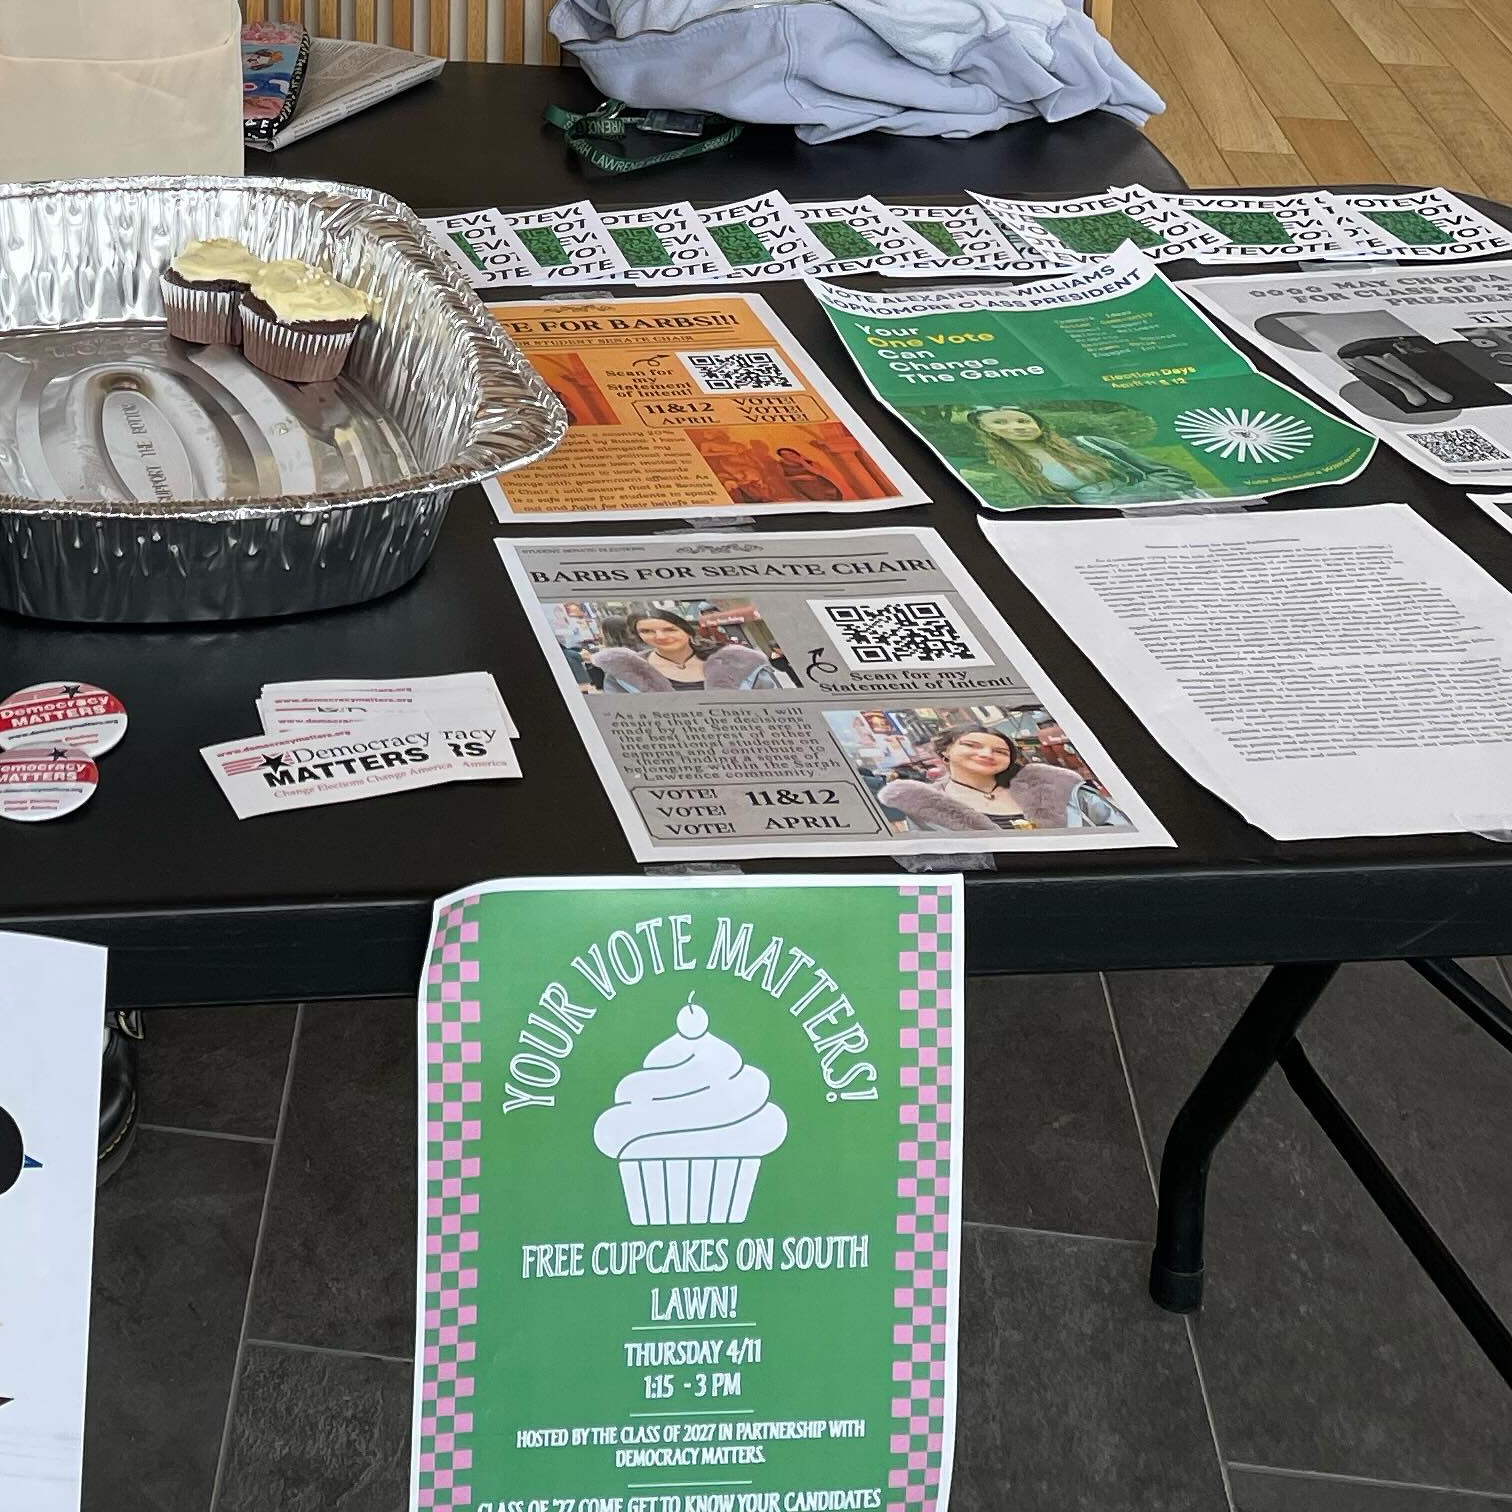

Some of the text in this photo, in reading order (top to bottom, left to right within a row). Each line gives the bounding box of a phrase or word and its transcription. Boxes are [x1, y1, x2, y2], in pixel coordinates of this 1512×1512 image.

[820, 265, 1116, 305] VOTE ALEXANDRA WILLIAMS
[961, 299, 1028, 310] CLASS
[1030, 268, 1143, 307] PRESIDENT
[1332, 273, 1510, 289] MAY CHOPRA
[1293, 285, 1477, 304] FOR CLASS OF
[539, 314, 740, 333] FOR BARBS!!!
[854, 322, 920, 338] Your
[866, 331, 996, 349] One Vote
[877, 348, 936, 360] Can
[647, 368, 674, 376] for
[888, 356, 1000, 373] Change
[631, 376, 656, 385] my
[897, 364, 1046, 384] The Game
[1102, 366, 1198, 382] Election Days
[607, 382, 692, 391] Statement
[616, 388, 694, 398] of Intent!
[644, 402, 715, 414] 11&12
[730, 397, 797, 407] VOTE!
[738, 405, 804, 414] VOTE!
[661, 415, 721, 426] APRIL
[741, 413, 810, 423] VOTE!
[529, 558, 938, 584] BARBS FOR SENATE CHAIR!
[818, 676, 1016, 694] Statement of Intent!
[851, 669, 969, 683] Scan for my
[0, 694, 110, 720] Democracy
[10, 705, 107, 728] MATTERS
[292, 731, 432, 764] Democracy
[262, 747, 431, 789] MATTERS
[624, 758, 842, 776] belonging within the Sarah
[273, 761, 454, 800] Change Elections Change America
[642, 771, 721, 782] Lawrence
[647, 788, 719, 801] VOTE!
[744, 789, 841, 807] 11&12
[656, 804, 728, 819] VOTE!
[665, 822, 738, 836] VOTE!
[765, 815, 852, 830] APRIL
[502, 914, 879, 1114] YOUR VOTE MATTERS!
[521, 1235, 869, 1279] FREE CUPCAKES ON SOUTH
[650, 1286, 739, 1322] LAWN!
[624, 1338, 762, 1367] THURSDAY 4/11
[643, 1372, 742, 1400] 1:15 3 PM
[516, 1420, 866, 1448] HOSTED BY THE CLASS OF 2027 IN PARTNERSHIP WITH
[615, 1449, 700, 1468] DEMOCRACY
[684, 1489, 882, 1512] KNOW YOUR CANDIDATES
